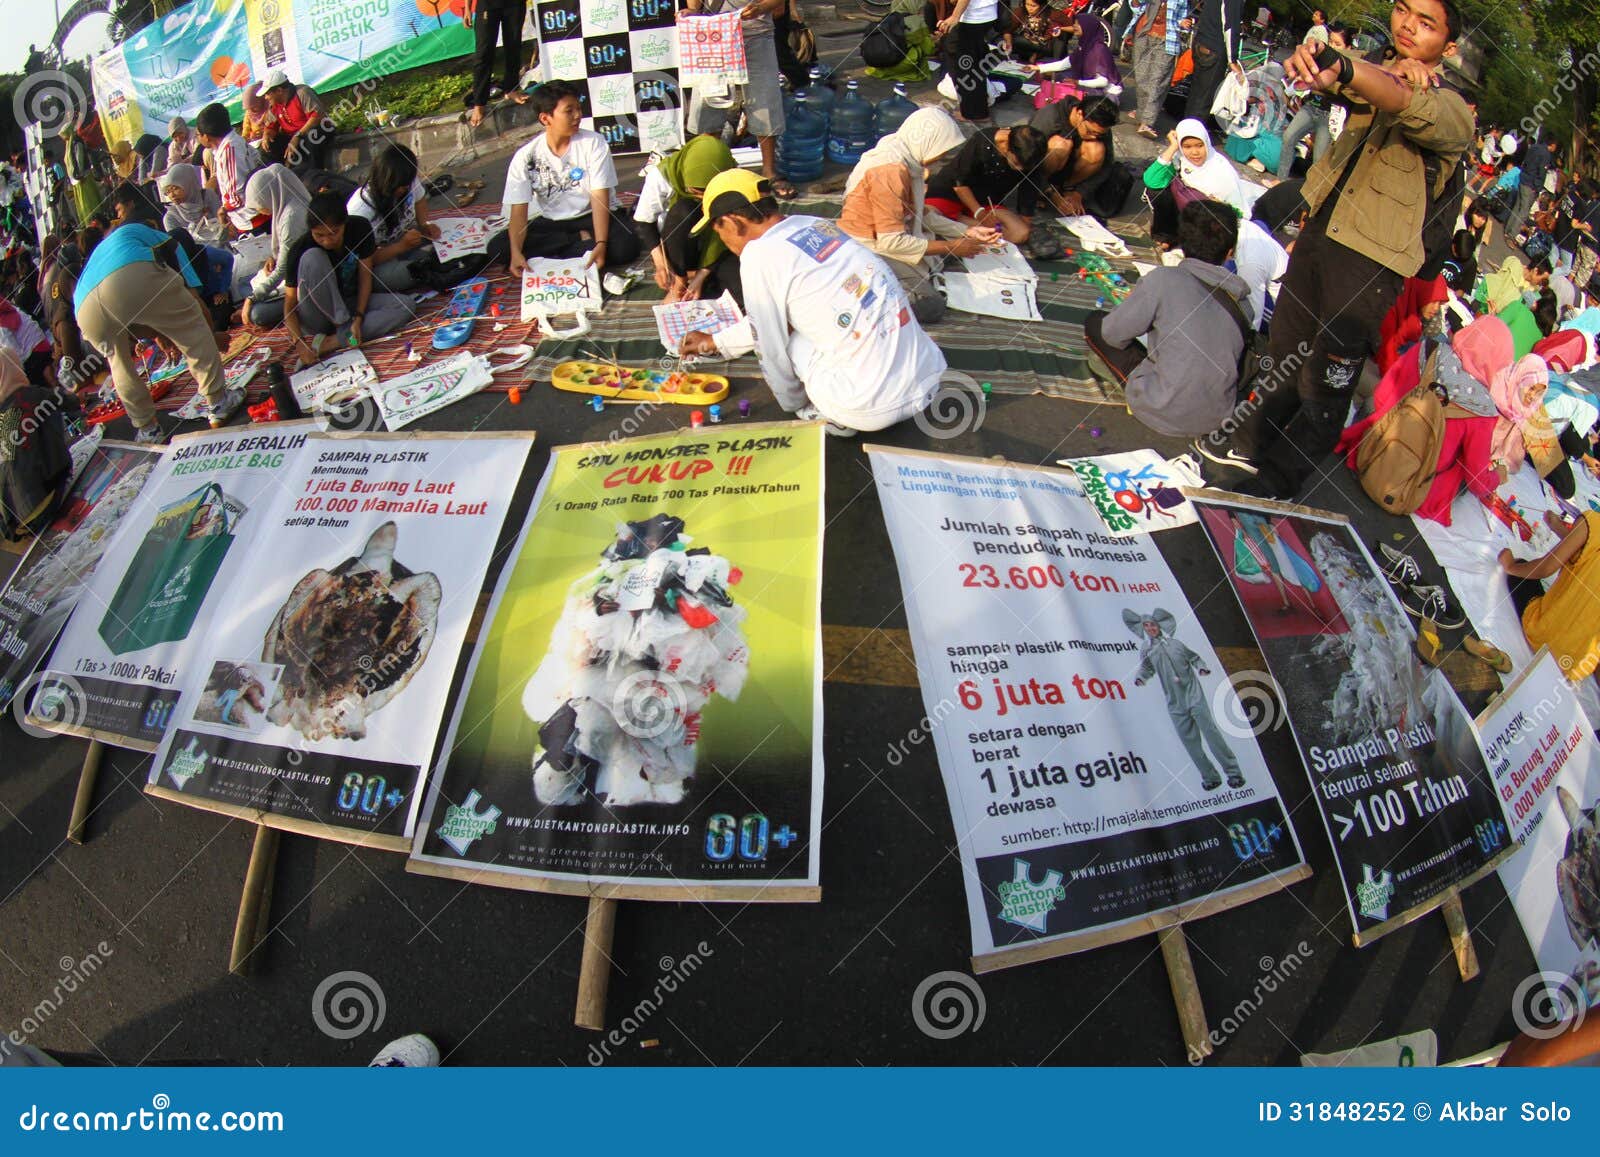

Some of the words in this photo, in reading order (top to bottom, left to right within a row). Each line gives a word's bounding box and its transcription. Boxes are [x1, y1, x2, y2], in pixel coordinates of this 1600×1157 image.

[312, 0, 389, 33] kantong
[314, 18, 375, 54] plastik
[172, 440, 235, 461] SAATNYA
[236, 433, 308, 452] BERALIH
[577, 454, 620, 470] SATU
[623, 443, 710, 463] MONSTER
[716, 436, 793, 454] PLASTIK
[171, 453, 244, 476] REUSABLE
[247, 453, 285, 468] BAG
[318, 452, 370, 463] SAMPAH
[373, 451, 429, 463] PLASTIK
[311, 466, 368, 476] Membunuh
[603, 458, 714, 489] CUKUP
[898, 467, 952, 481] Menurut
[956, 472, 1028, 488] perhitungan
[304, 480, 313, 492] 1
[312, 480, 347, 495] juta
[350, 480, 410, 496] Burung
[413, 480, 456, 495] Laut
[555, 502, 561, 512] 1
[564, 500, 598, 513] Orang
[601, 496, 627, 507] Rata
[631, 493, 658, 504] Rata
[662, 489, 685, 500] 700
[688, 487, 709, 499] Tas
[712, 483, 801, 497] Plastik/Tahun
[901, 481, 977, 497] Lingkungan
[294, 497, 358, 513] 100.000
[360, 498, 438, 514] Mamalia
[444, 500, 488, 515] Laut
[284, 517, 315, 528] setiap
[317, 517, 349, 528] tahun
[941, 517, 1010, 536] Jumlah
[1016, 523, 1082, 544] sampah
[1086, 531, 1138, 553] plastik
[973, 539, 1063, 558] penduduk
[1069, 543, 1147, 562] Indonesia
[958, 563, 1065, 591] 23.600
[1070, 570, 1119, 594] ton
[1128, 583, 1161, 595] HARI
[946, 640, 1011, 658] sampah
[1016, 640, 1065, 656] plastik
[1068, 637, 1139, 654] menumpuk
[75, 658, 82, 671] 1
[83, 658, 98, 672] Tas
[109, 660, 141, 680] 1000x
[141, 664, 177, 685] Pakai
[950, 657, 1009, 675] hingga
[957, 679, 983, 711] 6
[992, 676, 1065, 716] juta
[1072, 672, 1126, 701] ton
[968, 727, 1024, 744] setara
[1028, 721, 1086, 741] dengan
[972, 744, 1021, 763] berat
[1309, 733, 1387, 773] Sampah
[1385, 720, 1436, 753] Plastik
[1510, 748, 1544, 789] Burung
[1539, 723, 1561, 753] Laut
[1531, 748, 1568, 799] Mamalia
[1563, 723, 1584, 753] Laut
[980, 768, 997, 793] 1
[1007, 762, 1069, 798] juta
[1074, 751, 1147, 788] gajah
[1321, 768, 1373, 800] terurai
[1374, 758, 1418, 784] selama
[335, 771, 405, 816] 60+
[986, 795, 1057, 817] dewasa
[1332, 789, 1405, 841] >100
[1403, 774, 1468, 818] Tahun
[439, 825, 482, 840] plastik
[445, 815, 498, 835] kantong
[506, 816, 690, 836] WWW.DIETKANTONGPLASTIK.INFO
[1525, 810, 1544, 837] tahun
[705, 812, 797, 861] 60+
[1001, 826, 1061, 846] sumber:
[1070, 837, 1220, 880] WWW.DIETKANTONGPLASTIK.INFO
[1001, 884, 1066, 907] kantong
[1004, 899, 1056, 922] plastik
